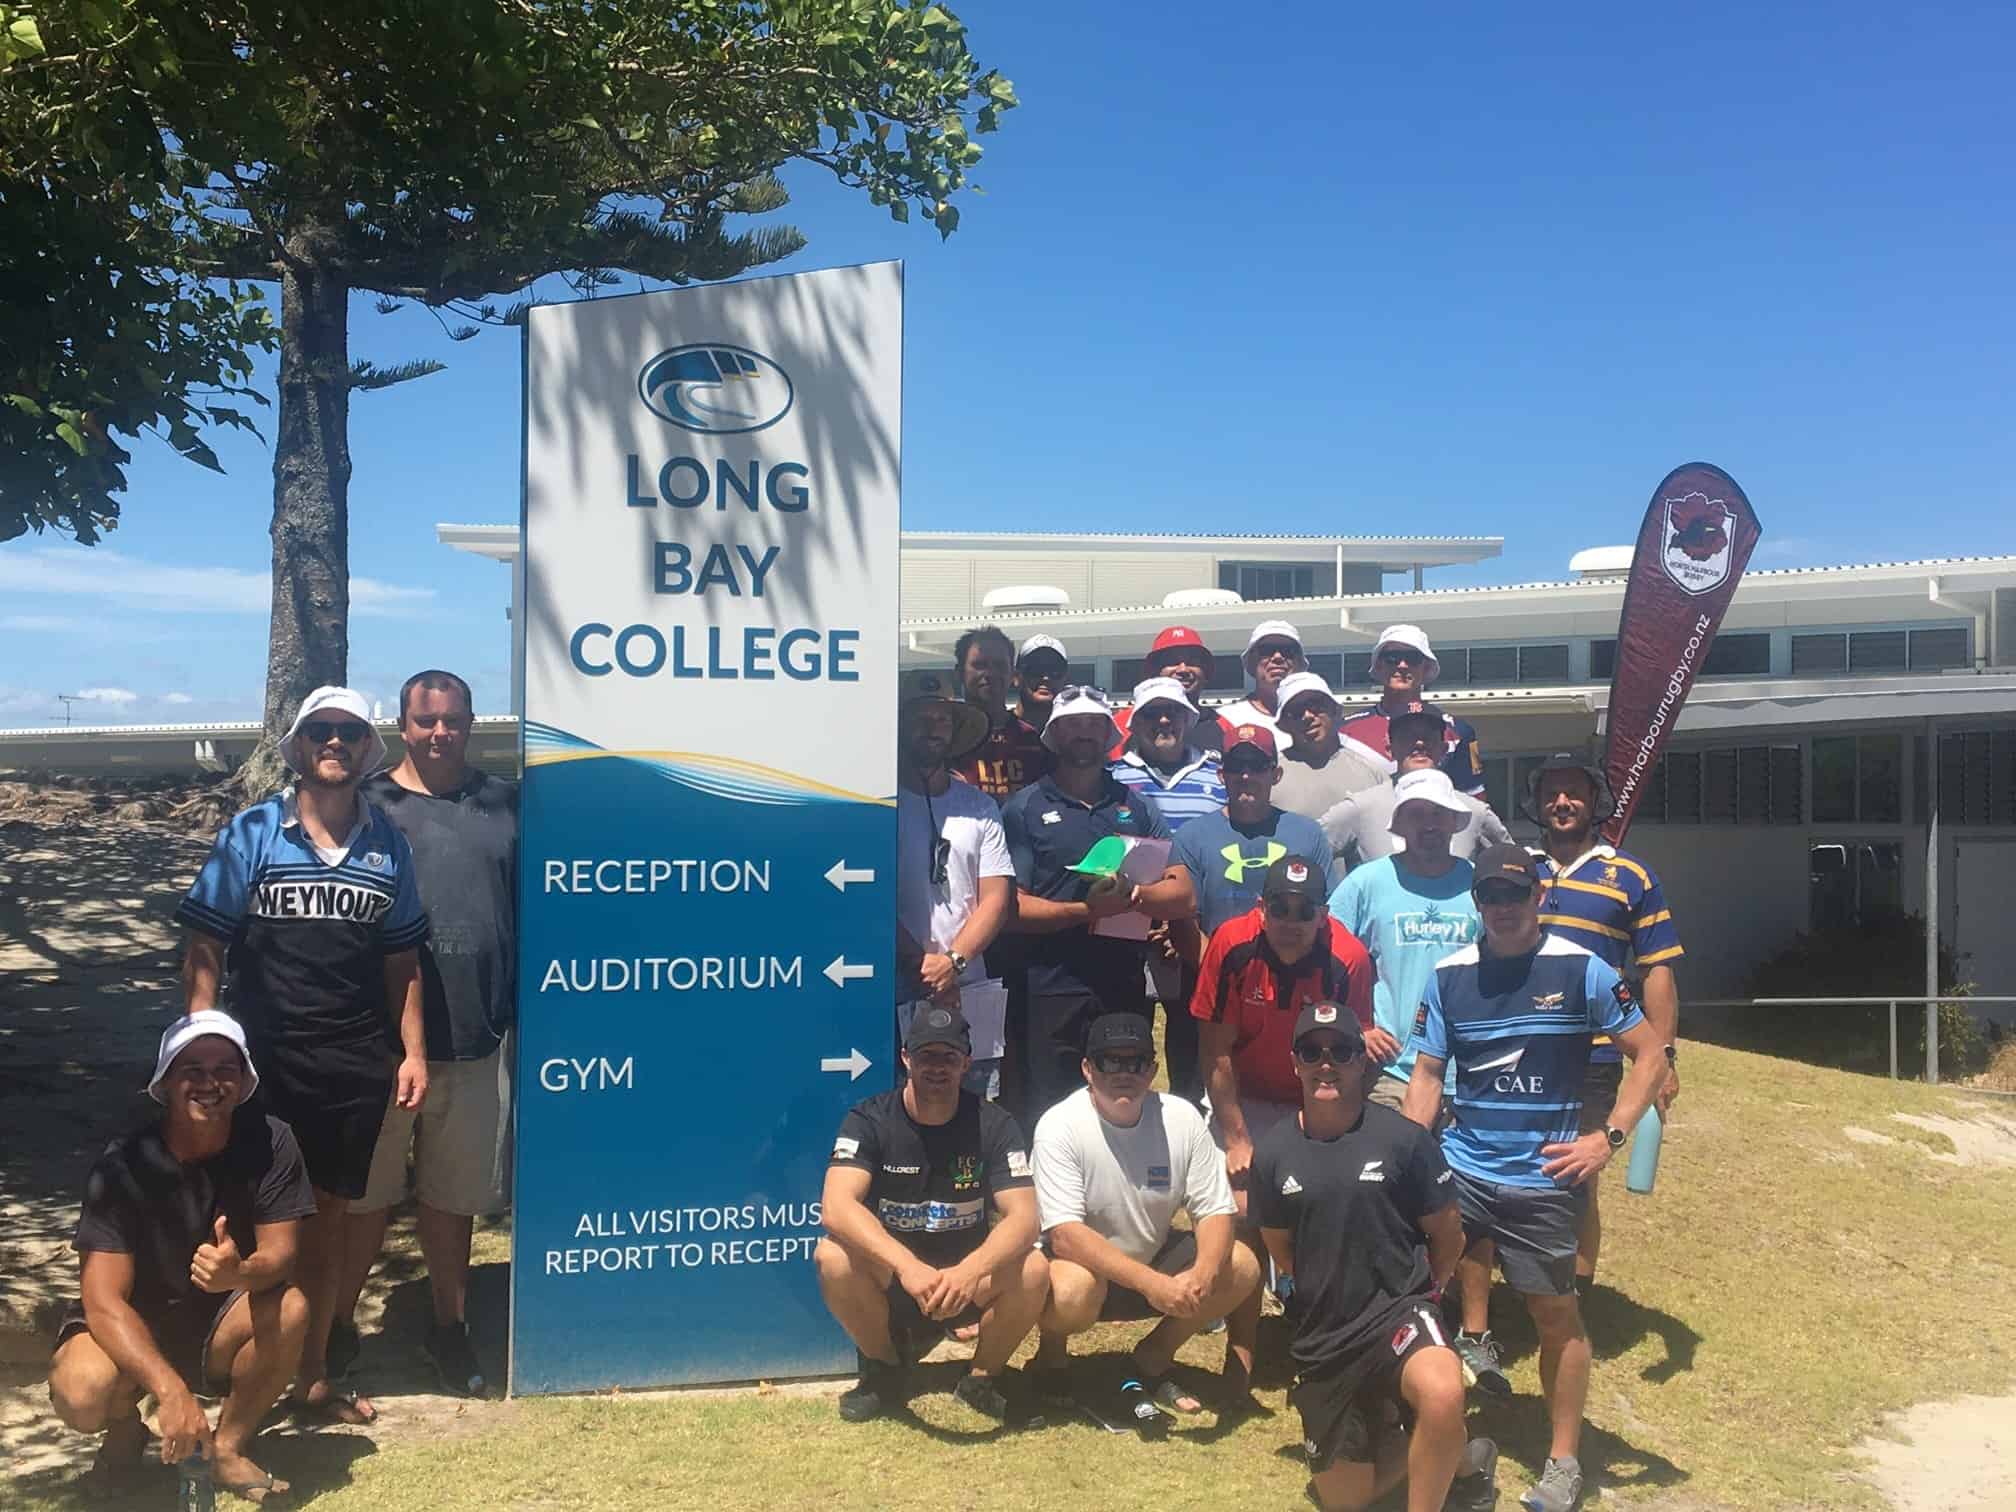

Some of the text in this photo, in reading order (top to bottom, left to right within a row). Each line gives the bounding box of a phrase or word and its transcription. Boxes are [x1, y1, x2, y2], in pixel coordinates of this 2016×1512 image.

[626, 454, 809, 513] LONG
[654, 541, 780, 598] BAY
[569, 622, 860, 682] COLLEGE
[1612, 613, 1711, 820] www.harbourrugby.co.nz
[544, 859, 771, 893] RECEPTION
[1404, 918, 1452, 939] Hurley
[540, 956, 803, 993] AUDITORIUM
[539, 1057, 634, 1093] GYM
[1494, 1075, 1544, 1094] CAE
[575, 1202, 823, 1238] ALL VISITORS MUS
[545, 1236, 822, 1275] REPORT TO RECEPT
